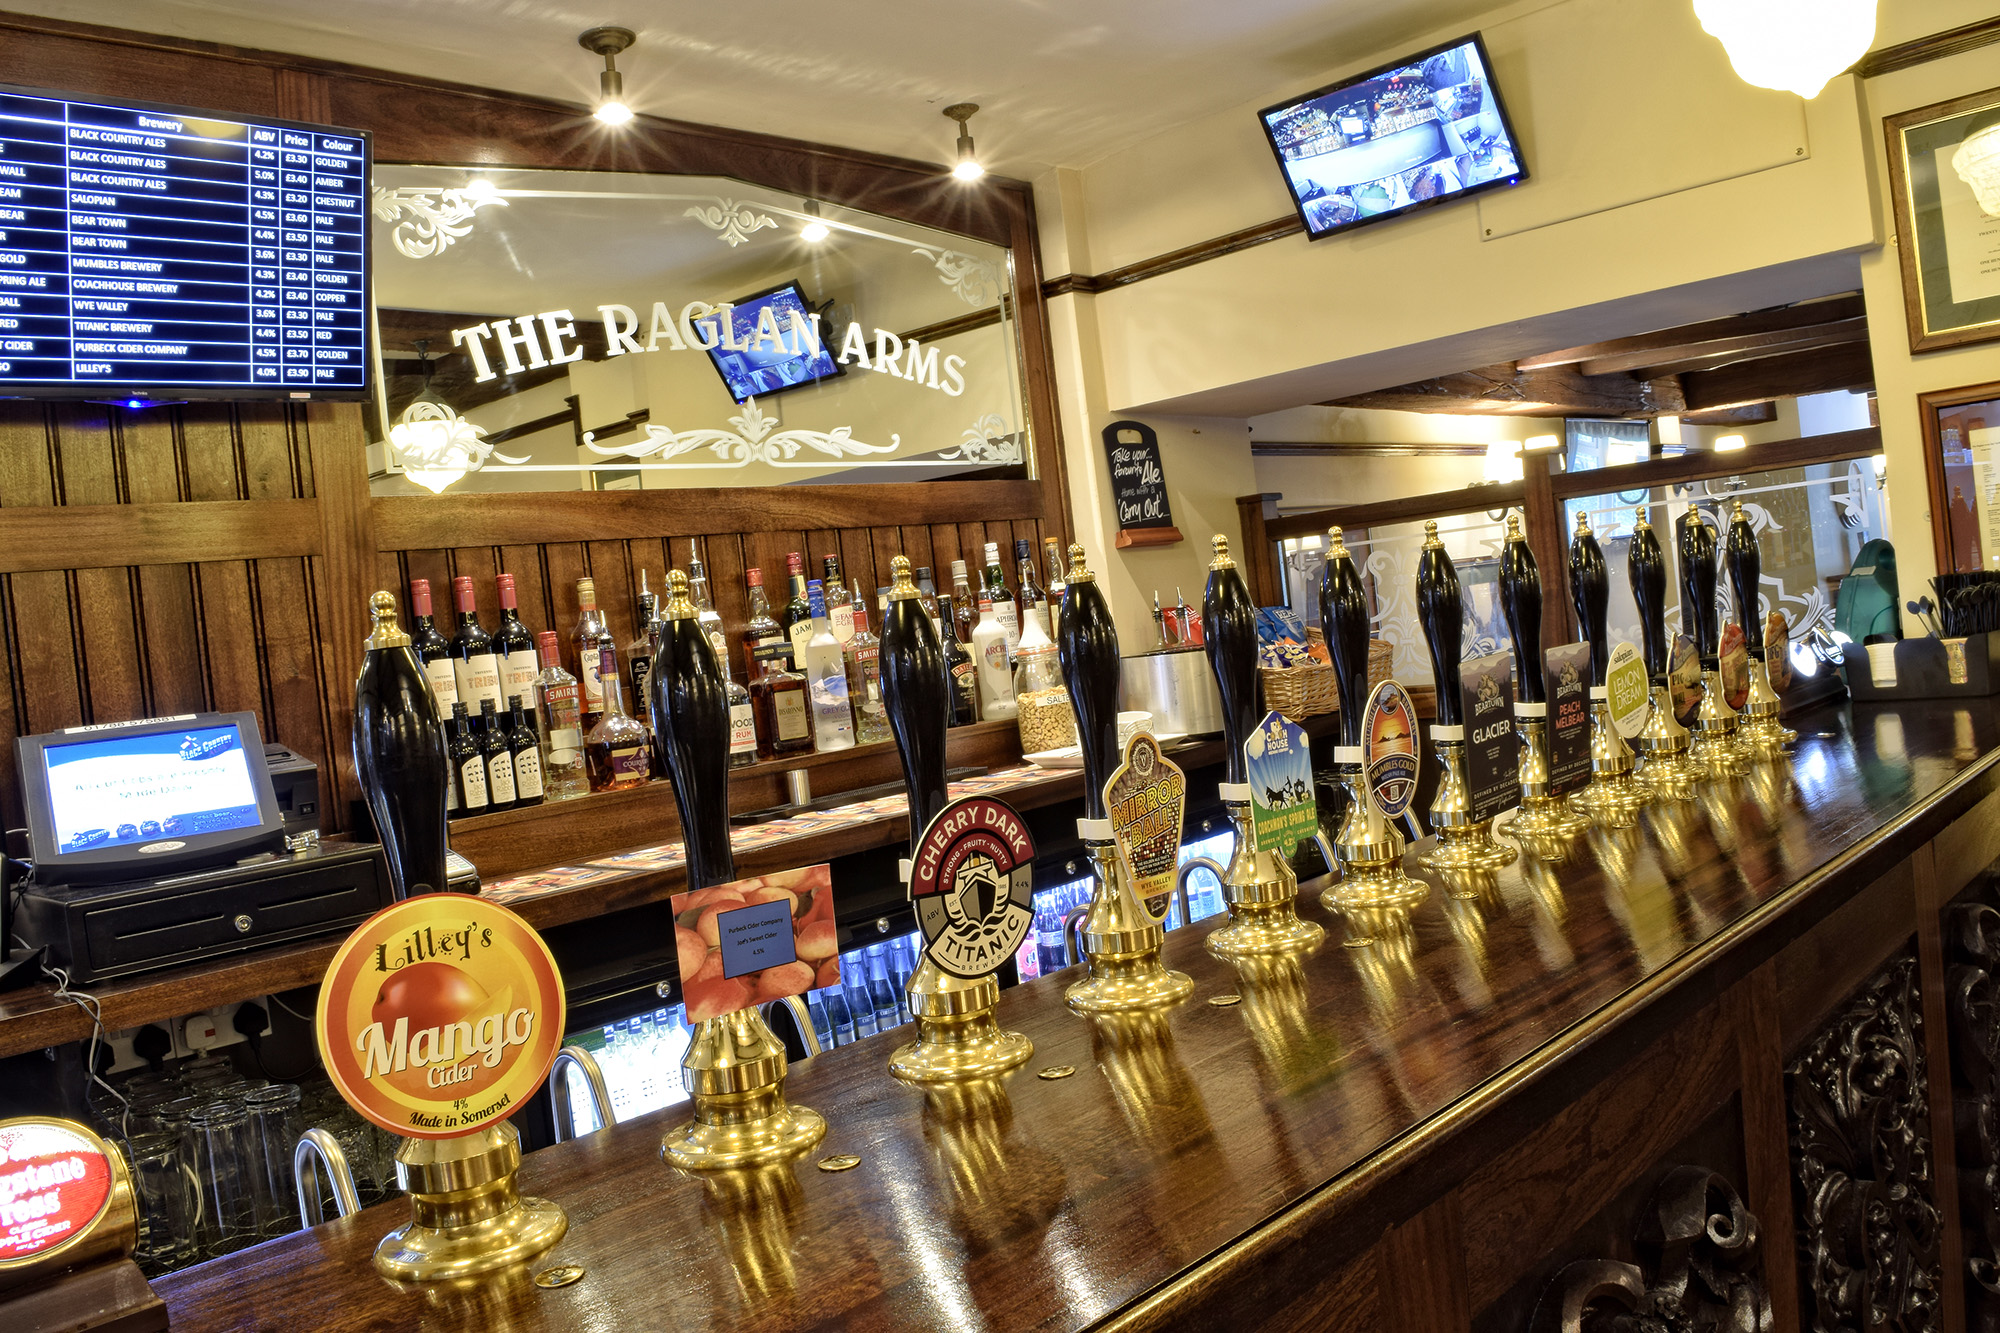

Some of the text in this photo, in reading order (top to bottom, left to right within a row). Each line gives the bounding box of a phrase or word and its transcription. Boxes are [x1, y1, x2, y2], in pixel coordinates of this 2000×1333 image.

[70, 128, 166, 148] BLACK COUNTRY ALES
[138, 116, 353, 151] Brewery ABV Price Colour
[70, 151, 166, 169] BLACK COUNTRY ALES
[254, 150, 275, 160] 4.2%
[285, 154, 307, 164] £3.30
[315, 157, 347, 168] GOLDEN
[0, 165, 26, 177] WALL
[254, 170, 275, 180] 5.0%
[71, 172, 166, 190] BLACK COUNTRY ALES
[285, 174, 307, 183] £3.40
[315, 177, 343, 187] AMBER
[71, 193, 116, 206] SALOPIAN
[254, 190, 275, 200] 4.3%
[285, 193, 307, 203] £3.20
[315, 196, 355, 208] CHESTNUT
[0, 209, 25, 220] BEAR
[254, 210, 275, 220] 4.5%
[285, 213, 307, 223] £3.60
[316, 215, 333, 225] PALE
[72, 215, 126, 228] BEAR TOWN
[255, 230, 275, 239] 4.4%
[285, 233, 307, 242] £3.50
[316, 236, 333, 244] PALE
[72, 236, 127, 249] BEAR TOWN
[0, 253, 26, 264] GOLD
[255, 250, 275, 259] 3.6%
[286, 252, 307, 262] £3.30
[316, 254, 334, 264] PALE
[73, 258, 162, 272] MUMBLES BREWERY
[255, 270, 275, 279] 4.3%
[286, 272, 308, 281] £3.40
[316, 274, 348, 284] GOLDEN
[28, 277, 46, 287] ALE
[73, 279, 178, 293] COACHHOUSE BREWERY
[256, 289, 276, 299] 4.2%
[286, 291, 308, 300] £3.40
[316, 293, 346, 302] COPPER
[74, 300, 128, 311] WYE VALLEY
[256, 309, 276, 318] 3.6%
[286, 311, 308, 320] £3.30
[316, 312, 334, 321] PALE
[0, 318, 18, 328] RED
[74, 321, 152, 333] TITANIC BREWERY
[256, 329, 276, 338] 4.4%
[287, 330, 308, 339] £3.50
[316, 331, 332, 340] RED
[5, 340, 33, 350] CIDER
[75, 342, 188, 355] PURBECK CIDER COMPANY
[452, 301, 967, 398] THE RAGLAN ARMS
[256, 349, 276, 358] 4.5%
[287, 349, 308, 358] £3.70
[316, 350, 348, 359] GOLDEN
[76, 363, 112, 373] LILLEY'S
[257, 368, 276, 377] 4.0%
[287, 368, 309, 377] £3.90
[317, 369, 335, 378] PALE
[1111, 447, 1131, 463] Take
[1141, 460, 1161, 485] Ale
[795, 624, 812, 636] JAM
[1613, 667, 1641, 695] LEMON
[1557, 682, 1582, 699] BEARTOWN
[1616, 685, 1643, 711] DREAM
[1475, 696, 1504, 716] BEARTOWN
[1560, 700, 1580, 715] PEACH
[1555, 711, 1585, 730] MELBEAR
[735, 730, 751, 739] RUM
[1473, 720, 1511, 744] GLACIER
[1267, 739, 1289, 751] HOUSE
[1371, 759, 1398, 780] MUMBLES
[1398, 760, 1415, 772] GOLD
[1552, 765, 1567, 775] DEFINED
[1474, 787, 1492, 800] DEFINED
[1110, 772, 1184, 833] MIRROR
[1306, 807, 1316, 820] ALE
[985, 807, 1027, 854] DARK
[1129, 806, 1173, 850] BALL
[919, 806, 979, 881] CHERRY
[943, 839, 1008, 884] STRONG FRUITY NUTTY
[1015, 880, 1029, 888] 4.4%
[1153, 876, 1171, 886] VALLEY
[926, 909, 940, 922] ABV
[729, 925, 746, 934] Purbeck
[761, 918, 783, 926] Company
[945, 914, 1019, 962] TITANIC
[375, 921, 492, 972] Lilley's
[961, 949, 1008, 971] BREWERY
[356, 1007, 535, 1079] Mango
[426, 1062, 478, 1089] Cider
[453, 1098, 469, 1110] 4%
[409, 1093, 511, 1128] Made in Somerset
[32, 1220, 71, 1239] CIDER
